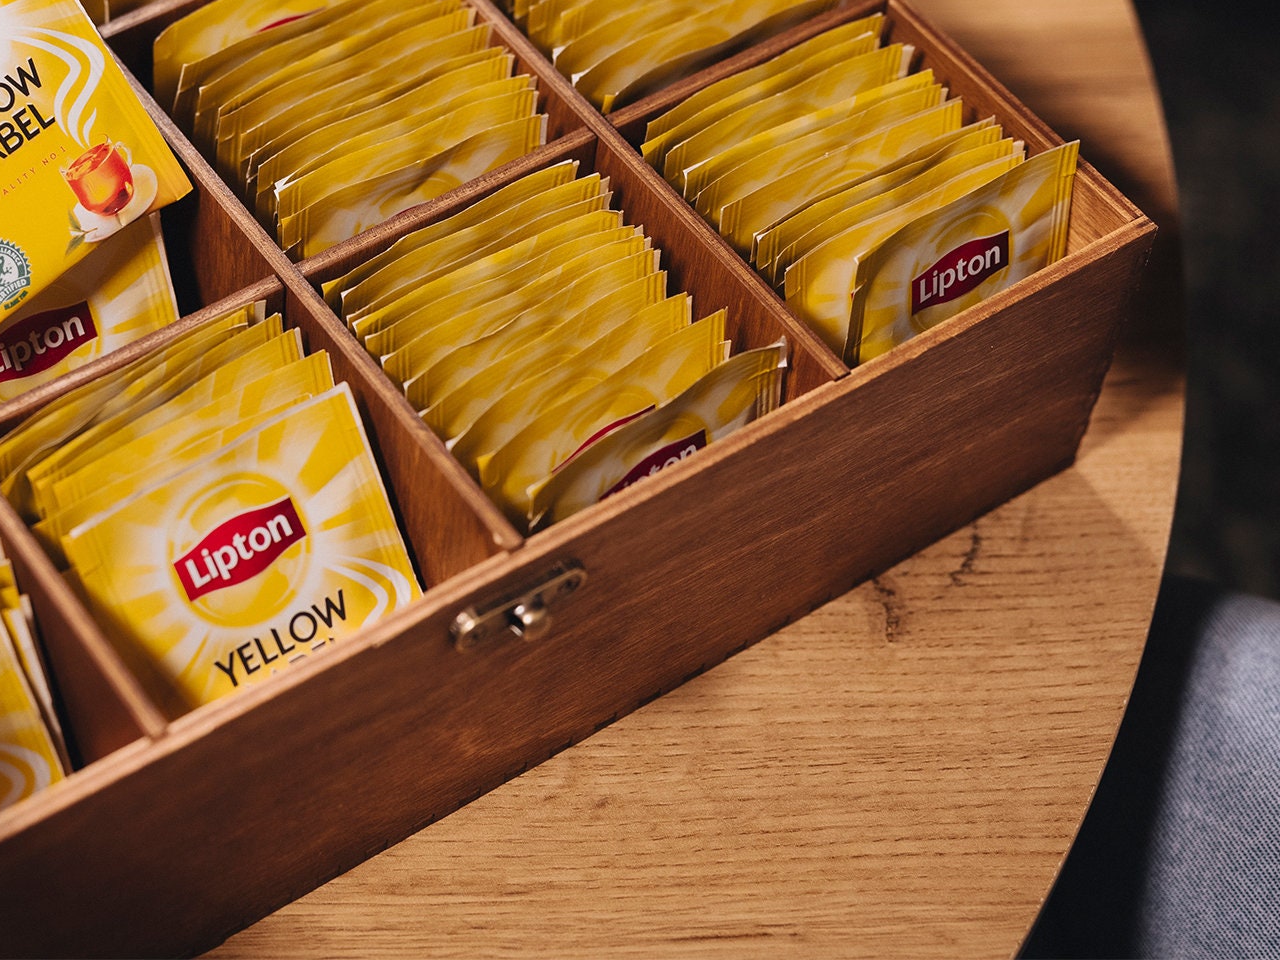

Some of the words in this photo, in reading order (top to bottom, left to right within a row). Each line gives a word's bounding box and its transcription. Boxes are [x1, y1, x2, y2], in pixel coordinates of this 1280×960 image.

[920, 245, 1000, 304] Lipton
[184, 513, 293, 589] Lipton
[214, 589, 347, 688] YELLOW
